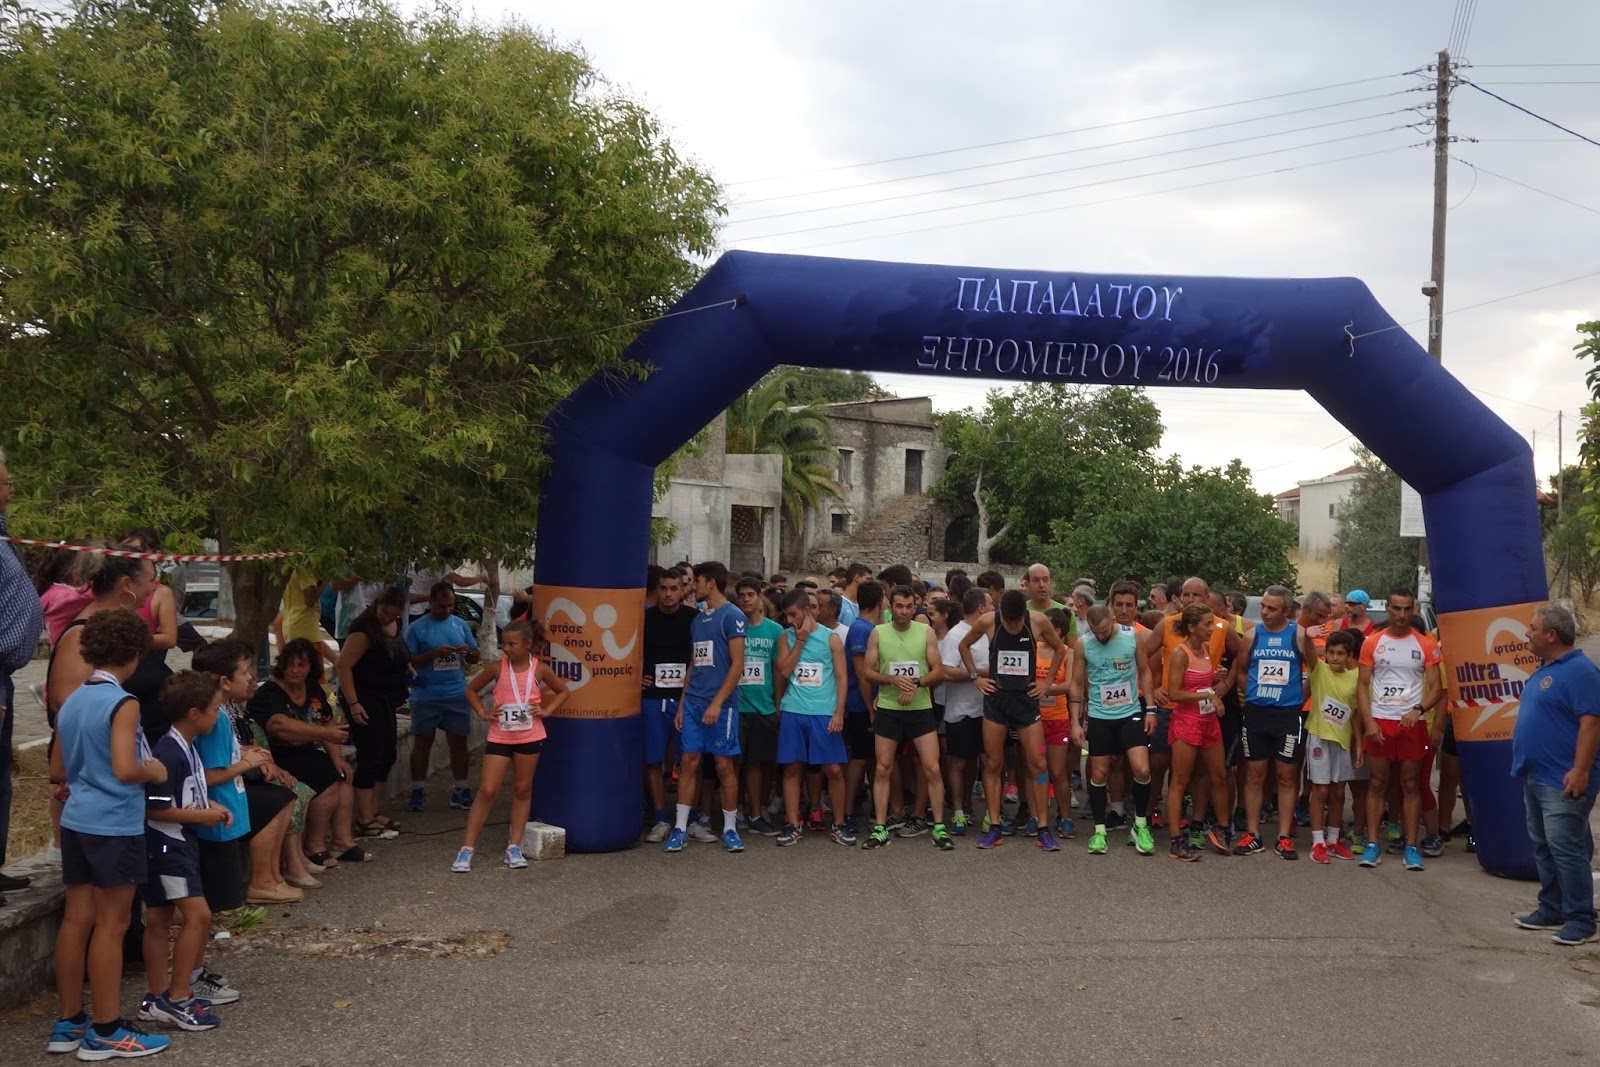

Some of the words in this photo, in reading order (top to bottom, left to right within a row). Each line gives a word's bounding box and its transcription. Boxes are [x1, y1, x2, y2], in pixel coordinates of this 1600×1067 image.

[953, 277, 1183, 321] ΠΑΠΑΔΑΤΟΥ
[916, 335, 1151, 380] ΞΗΡΟΜΕΡΟΥ
[1157, 346, 1222, 383] 2016
[549, 623, 583, 635] φτάσε
[564, 637, 592, 648] όπου
[1494, 641, 1529, 656] φτάσε
[585, 651, 605, 661] δεν
[695, 648, 708, 658] 282
[1003, 656, 1022, 667] 221
[592, 665, 633, 678] μπορείς
[660, 669, 681, 680] 222
[798, 668, 818, 678] 257
[893, 666, 915, 677] 220
[1262, 666, 1284, 677] 224
[1456, 662, 1500, 683] ultra
[1106, 688, 1126, 700] 244
[1256, 685, 1282, 702] KNAUF
[1383, 687, 1405, 697] 297
[1324, 704, 1345, 719] 203
[1279, 733, 1298, 757] KNAUF
